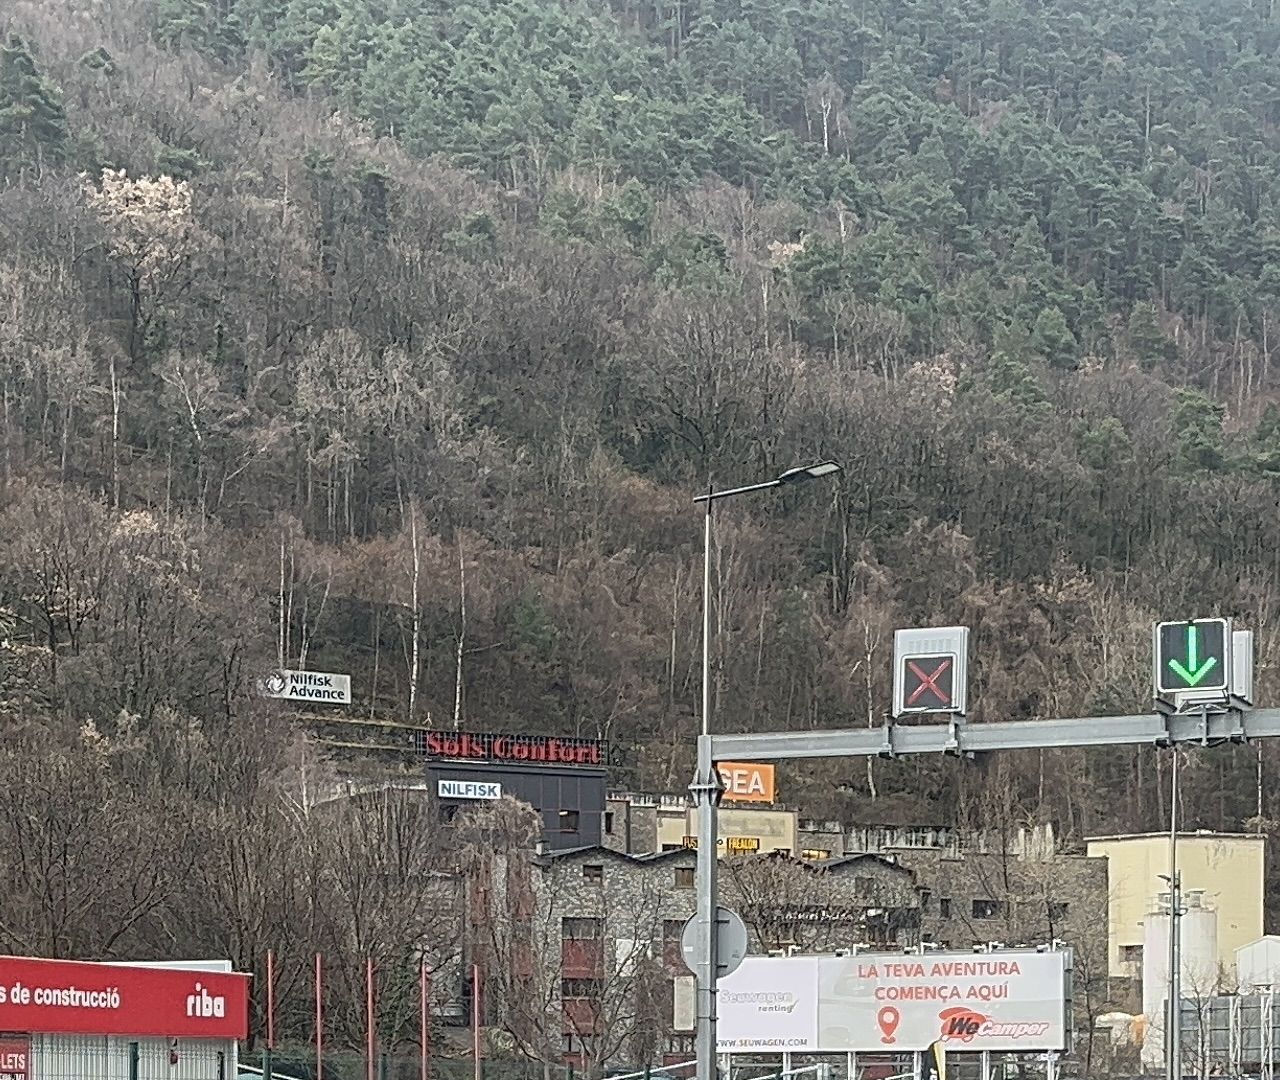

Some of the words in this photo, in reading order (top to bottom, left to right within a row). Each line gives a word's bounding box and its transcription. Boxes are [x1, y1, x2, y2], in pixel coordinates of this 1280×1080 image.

[290, 674, 333, 687] Nilfisk
[289, 685, 345, 700] Advance
[426, 732, 485, 758] Sols
[492, 735, 601, 764] Confort
[440, 783, 498, 797] NILFISK
[858, 963, 879, 979] LA
[884, 962, 925, 978] TEVA
[930, 961, 1021, 977] AVENTURA
[10, 982, 30, 1005] de
[33, 986, 121, 1009] construcció
[186, 982, 226, 1018] riba
[874, 985, 962, 1002] COMENÇA
[965, 981, 1008, 1001] AQUÍ
[758, 1004, 795, 1013] renting
